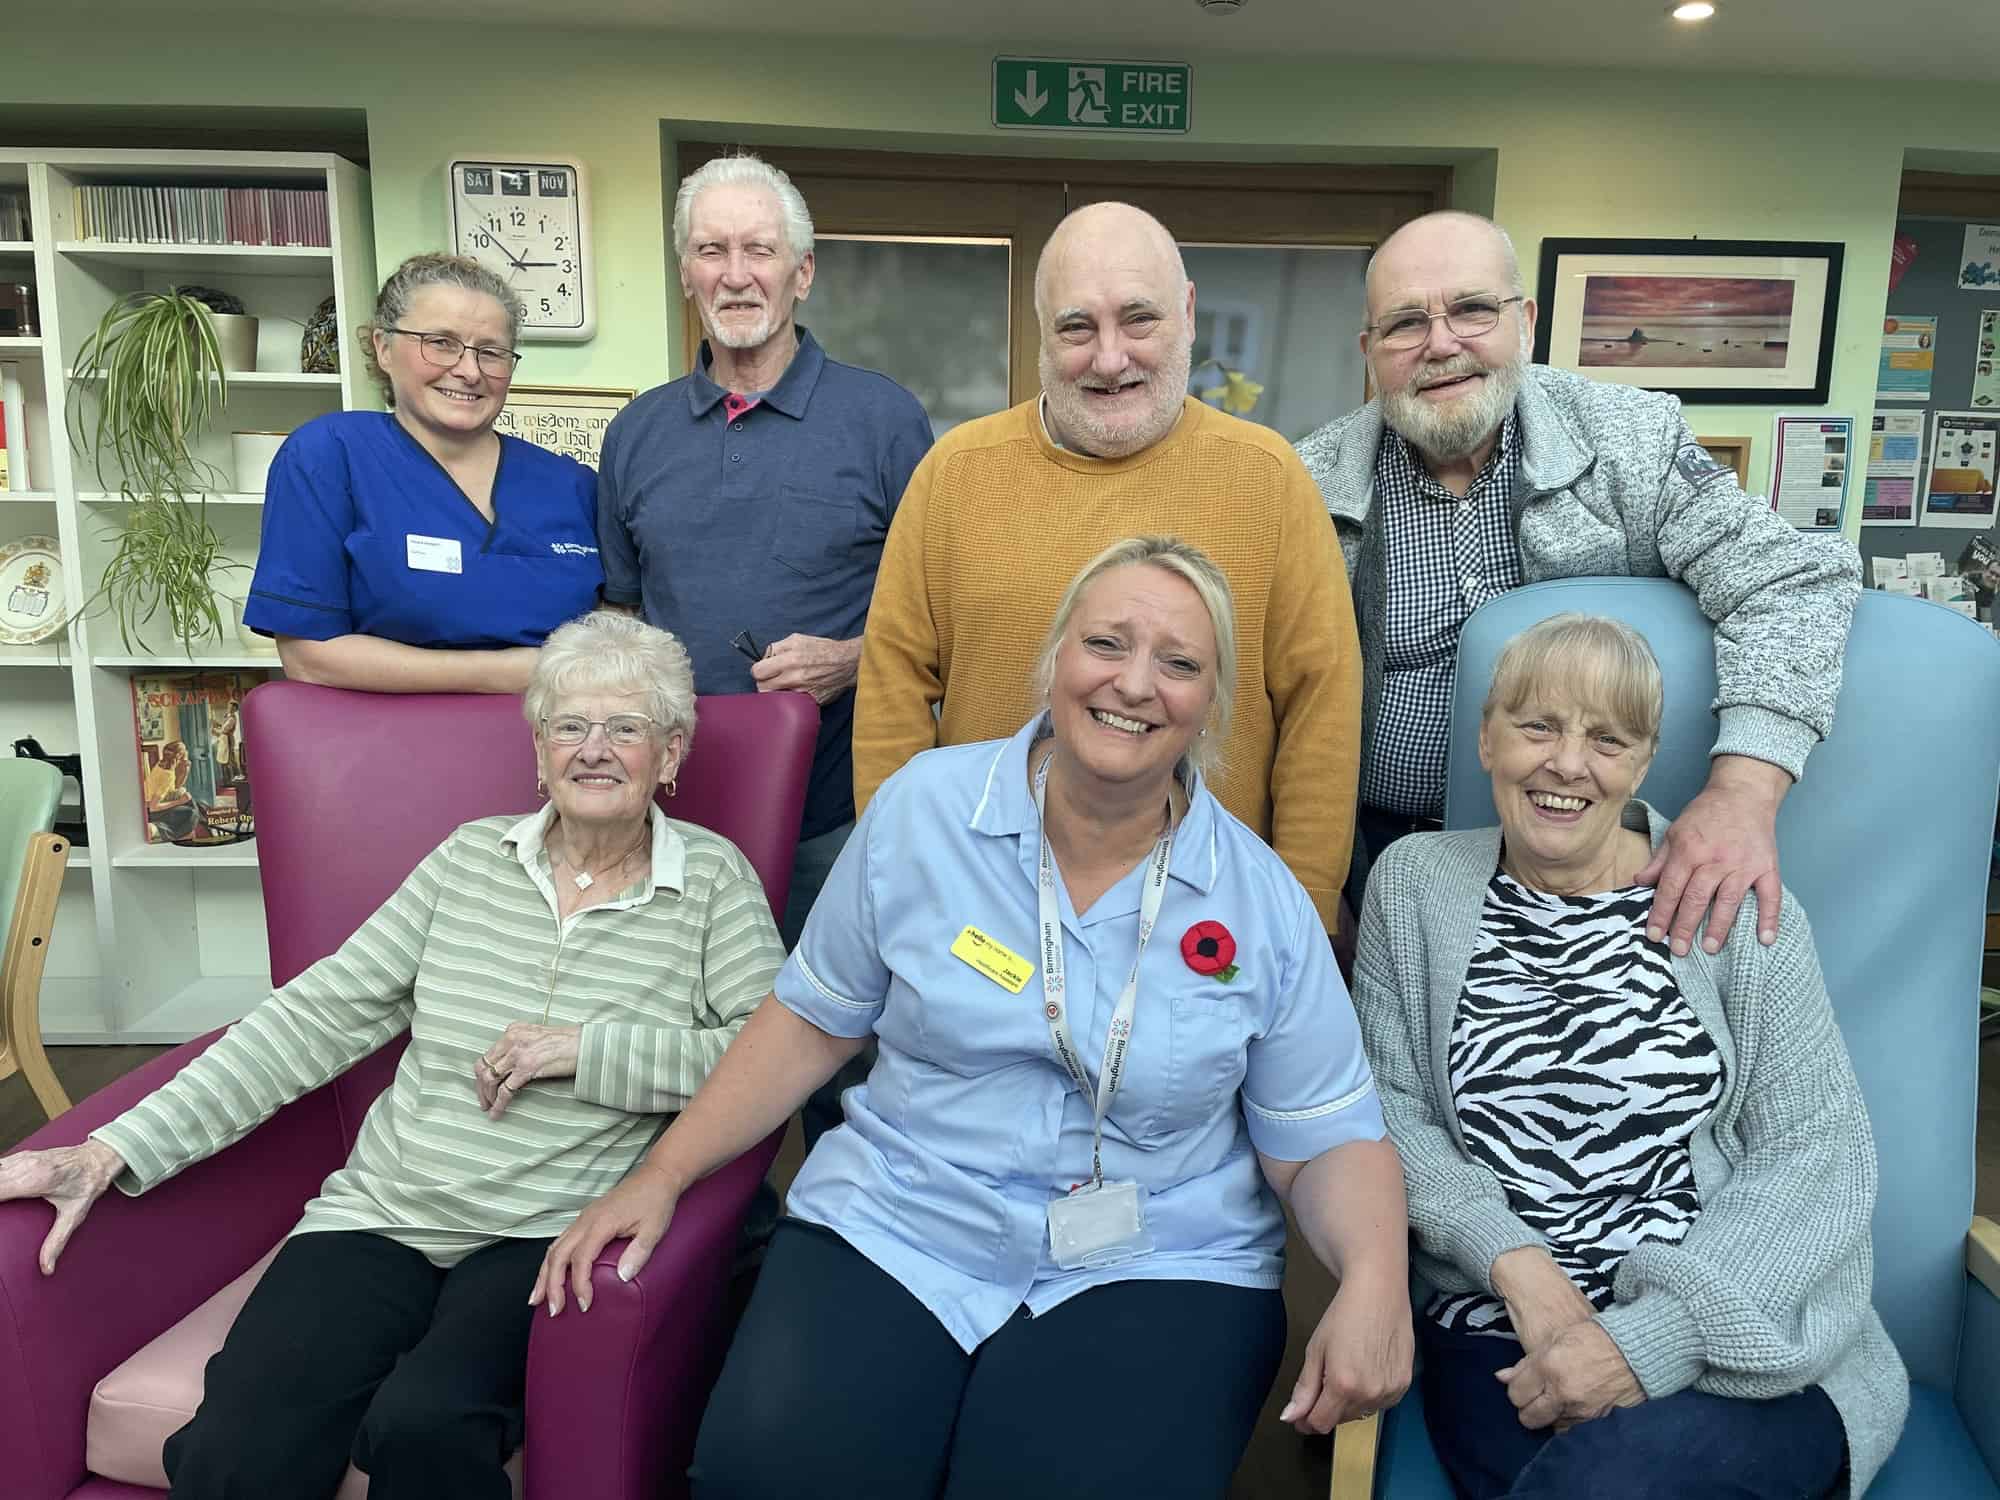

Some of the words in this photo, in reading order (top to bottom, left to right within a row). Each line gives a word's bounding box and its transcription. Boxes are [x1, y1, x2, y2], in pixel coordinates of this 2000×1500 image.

[1122, 71, 1182, 94] FIRE
[1121, 103, 1181, 125] EXIT
[466, 172, 489, 187] SAT
[509, 172, 523, 191] 4
[541, 175, 565, 190] NOV
[488, 217, 502, 233] 11
[509, 211, 526, 227] 12
[538, 219, 545, 234] 1
[473, 233, 490, 249] 10
[553, 236, 564, 251] 2
[562, 259, 572, 274] 3
[557, 283, 567, 297] 4
[519, 303, 528, 317] 6
[540, 298, 550, 313] 5
[1044, 922, 1055, 974] Birmingham
[1055, 1030, 1080, 1080] Birmingham
[1108, 1039, 1126, 1093] Birmingham
